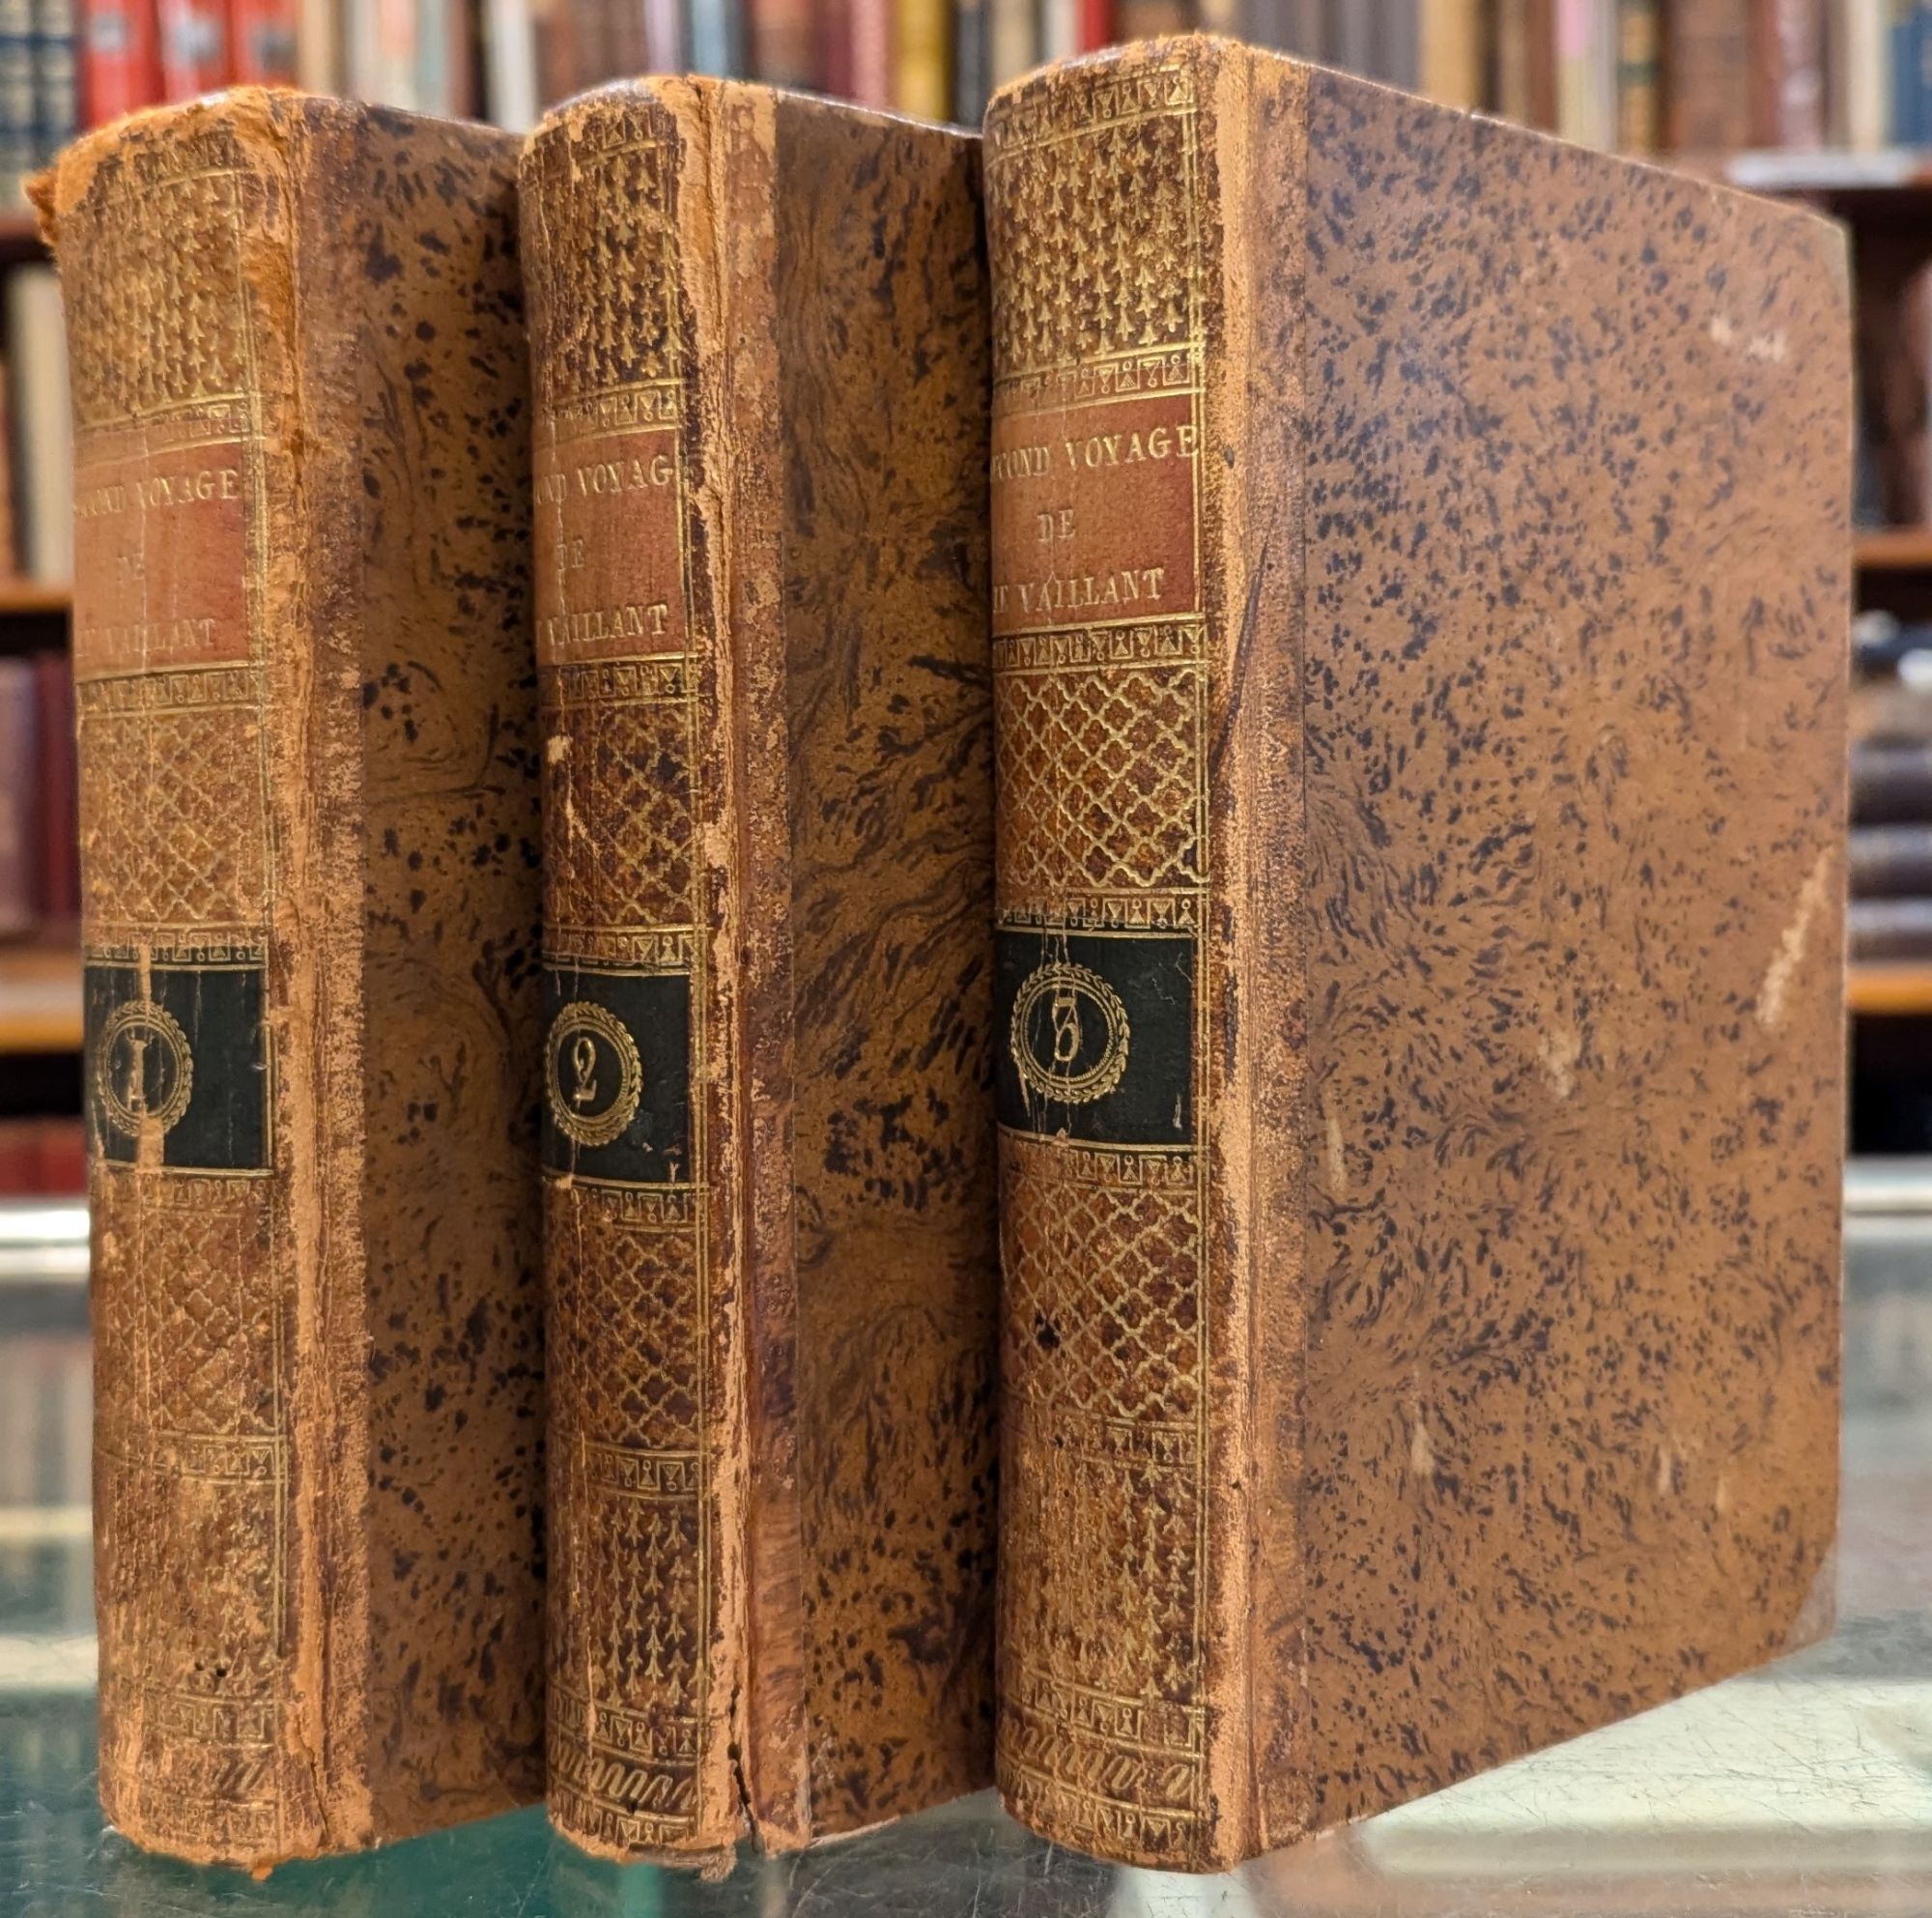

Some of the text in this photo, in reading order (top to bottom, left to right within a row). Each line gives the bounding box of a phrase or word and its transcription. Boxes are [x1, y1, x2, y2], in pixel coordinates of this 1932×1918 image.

[1065, 425, 1199, 472] VOYAGE
[578, 455, 674, 497] VOYAG
[1037, 509, 1075, 543] DE
[1017, 567, 1165, 615] VAILLANT
[1051, 996, 1082, 1062] 3
[572, 1036, 598, 1102] 2
